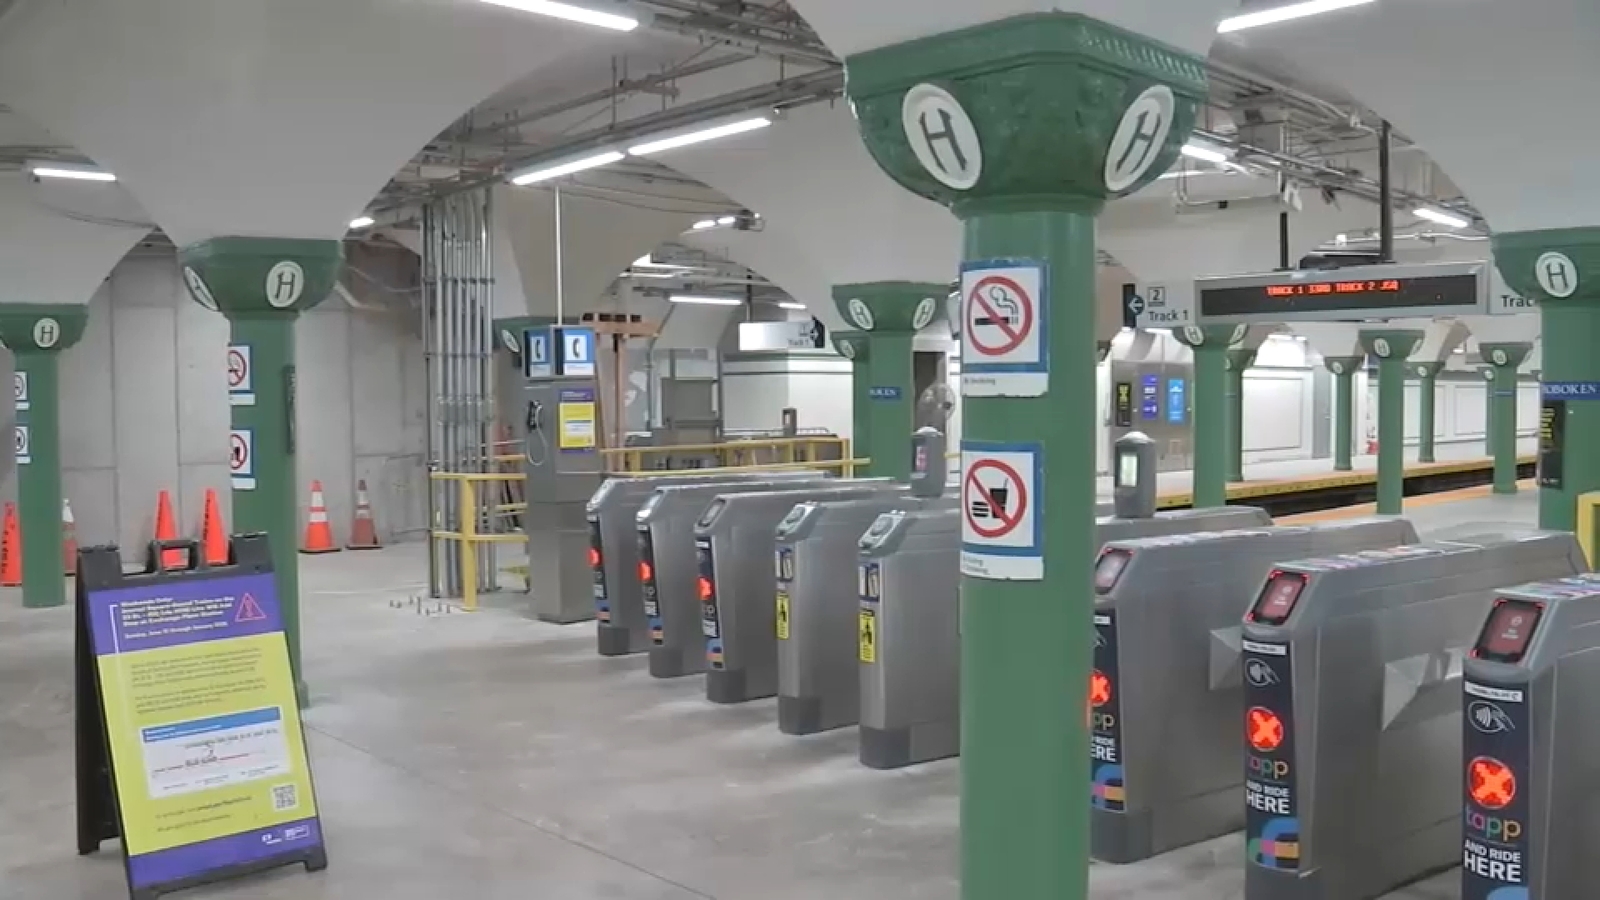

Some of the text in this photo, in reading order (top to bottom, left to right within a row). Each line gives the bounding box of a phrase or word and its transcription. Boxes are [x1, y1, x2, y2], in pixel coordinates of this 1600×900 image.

[918, 107, 968, 174] H
[1115, 110, 1163, 174] H
[274, 271, 297, 301] H
[1546, 263, 1569, 290] H
[1152, 289, 1161, 301] 2
[1501, 295, 1535, 307] Trac
[1148, 309, 1188, 321] Track 1
[41, 325, 55, 341] H
[1246, 789, 1290, 814] HERE
[1466, 803, 1521, 842] tapp
[1464, 839, 1521, 863] AND RIDE
[1464, 851, 1521, 883] HERE
